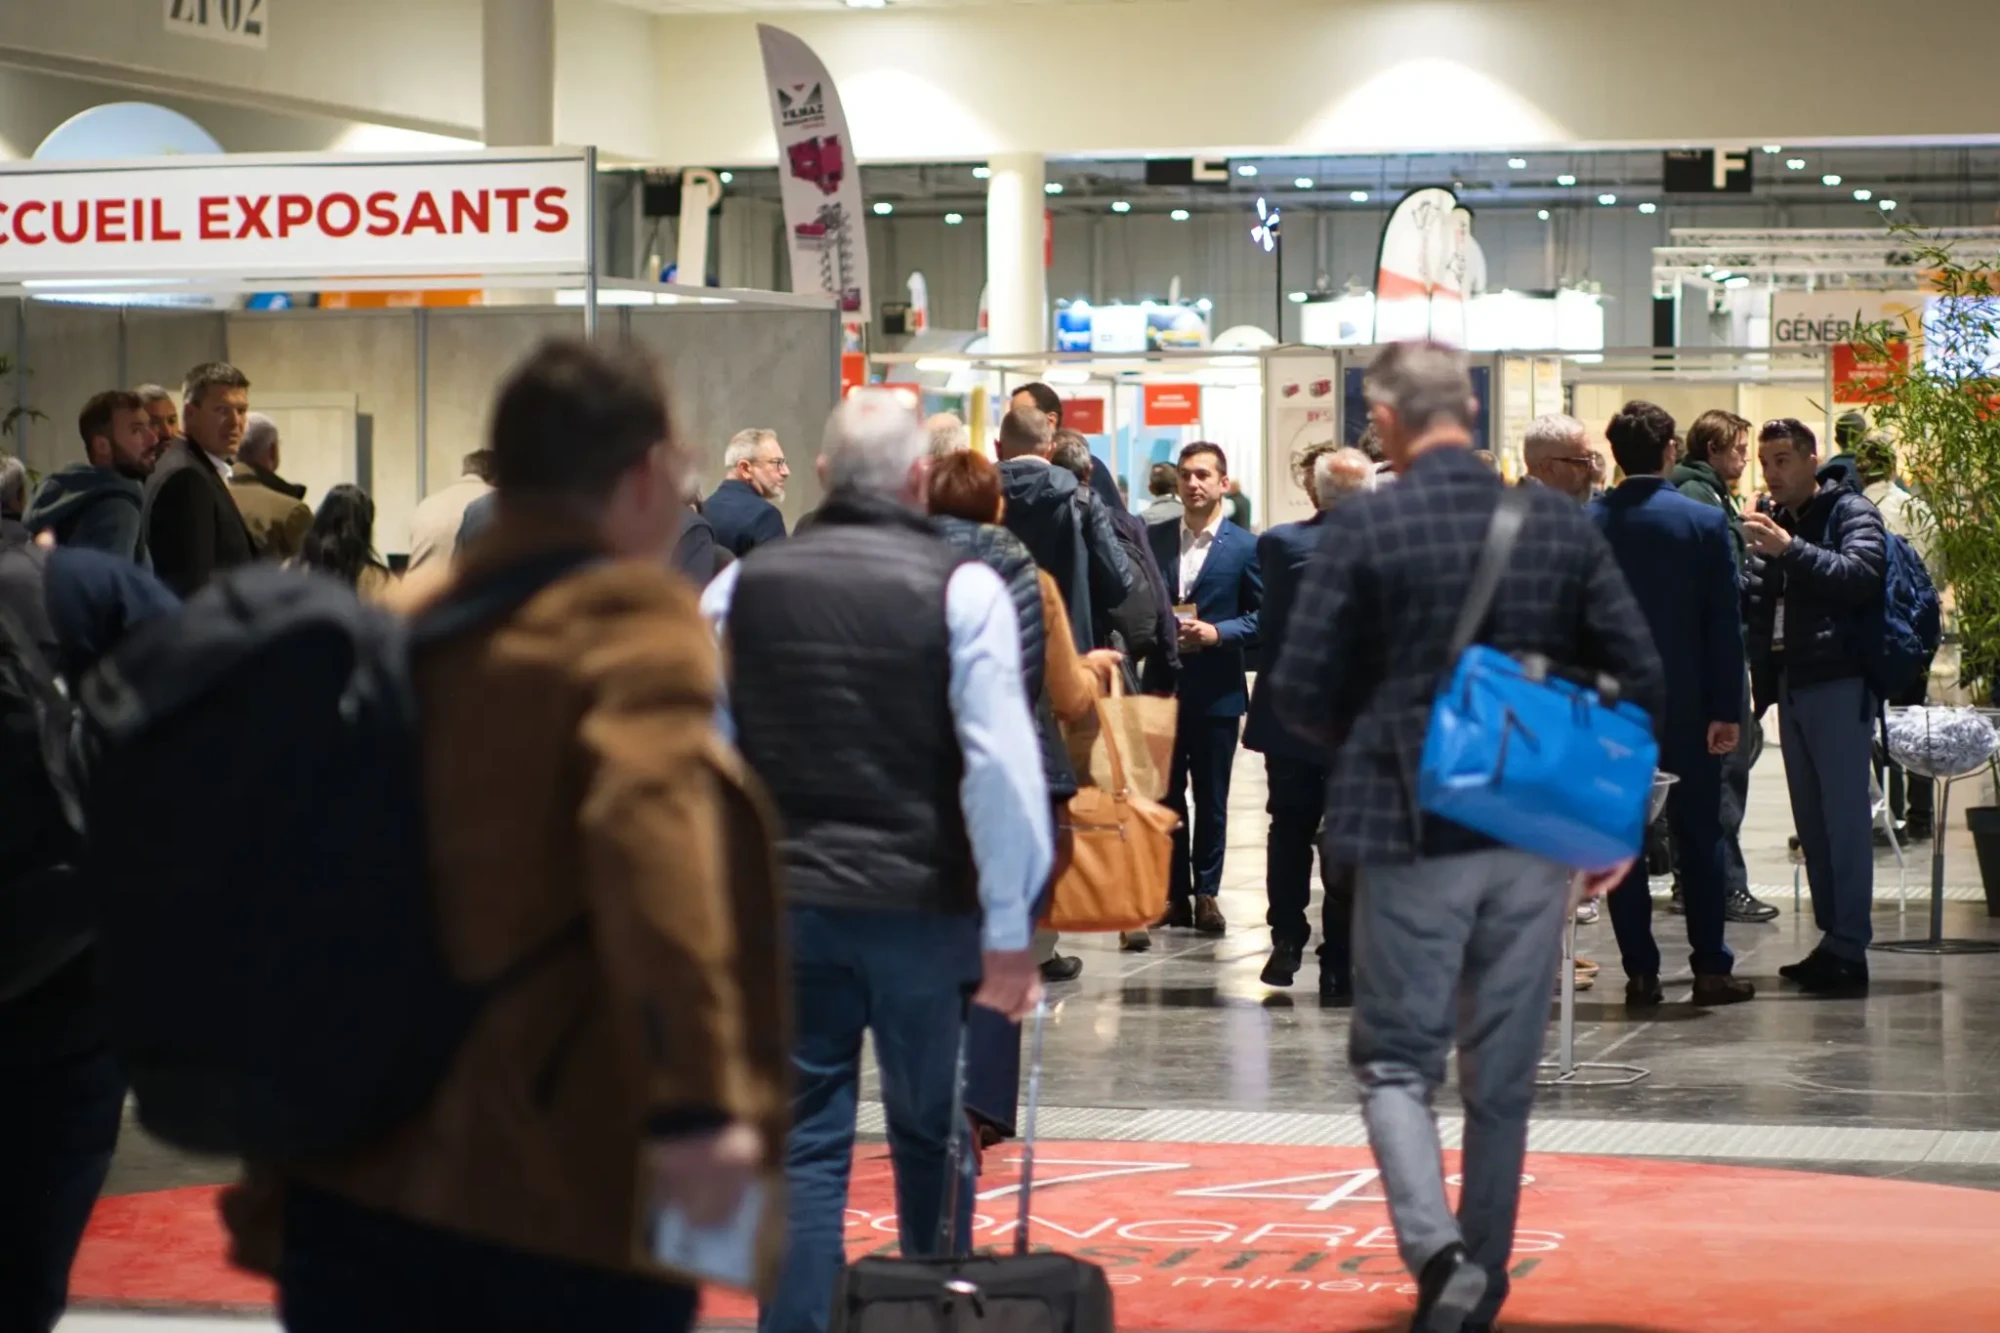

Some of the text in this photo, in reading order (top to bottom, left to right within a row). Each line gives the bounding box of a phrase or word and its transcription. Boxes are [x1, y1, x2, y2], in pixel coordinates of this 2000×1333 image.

[1713, 145, 1746, 188] F
[0, 186, 570, 246] CUEIL EXPOSANTS
[1775, 312, 1896, 343] GÉNÉR
